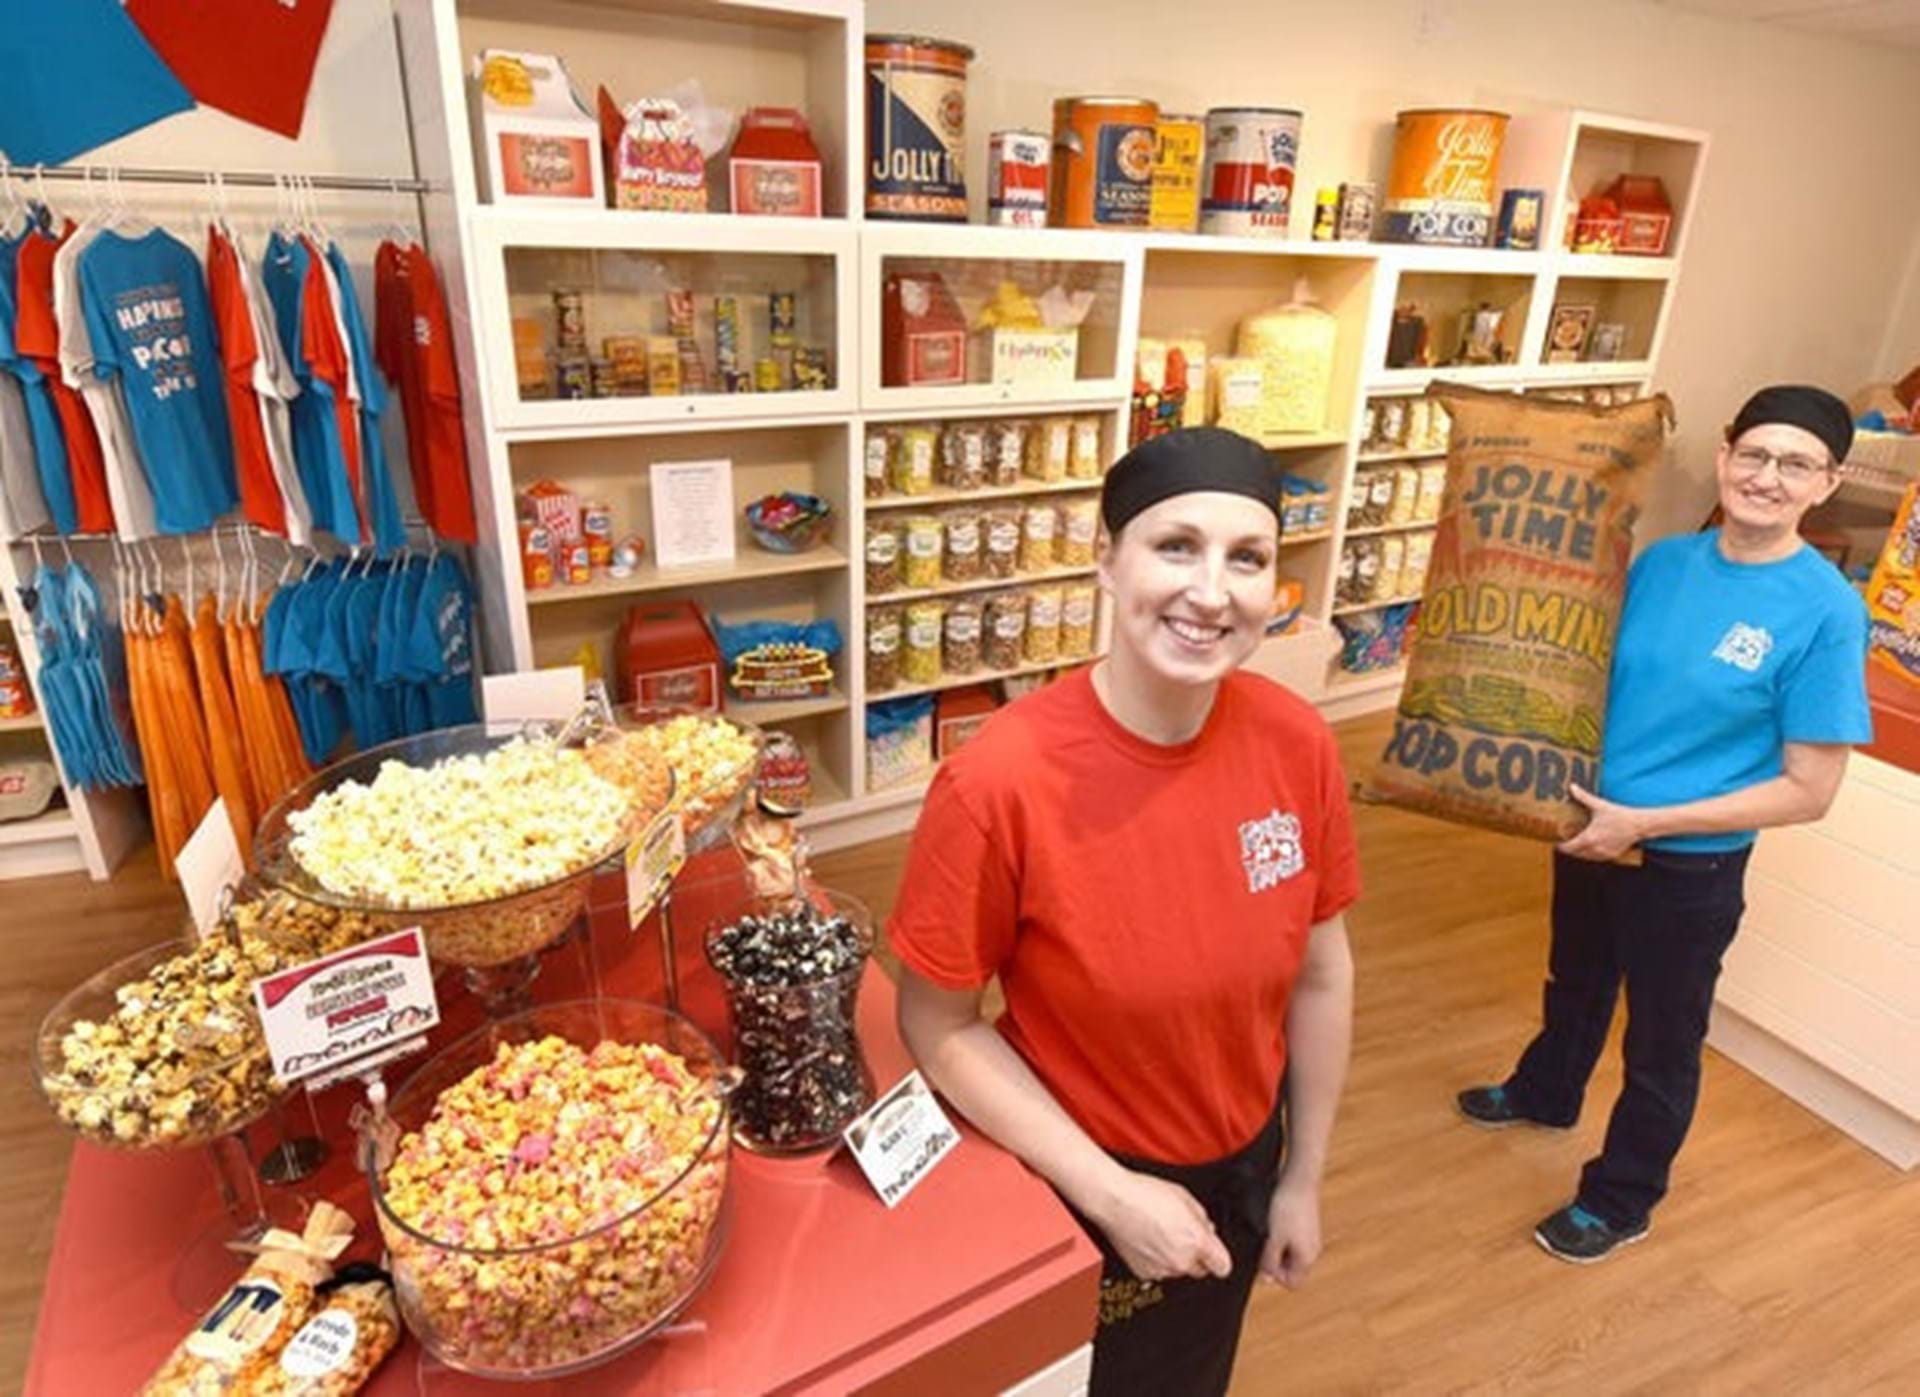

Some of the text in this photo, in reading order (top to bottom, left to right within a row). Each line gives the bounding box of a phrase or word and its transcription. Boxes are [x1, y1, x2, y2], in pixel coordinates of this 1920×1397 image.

[872, 61, 941, 182] JOLLY
[1463, 464, 1608, 521] JOLLY
[1471, 502, 1597, 561] TIME
[1513, 586, 1613, 671] MIN
[1462, 738, 1600, 802] CORN
